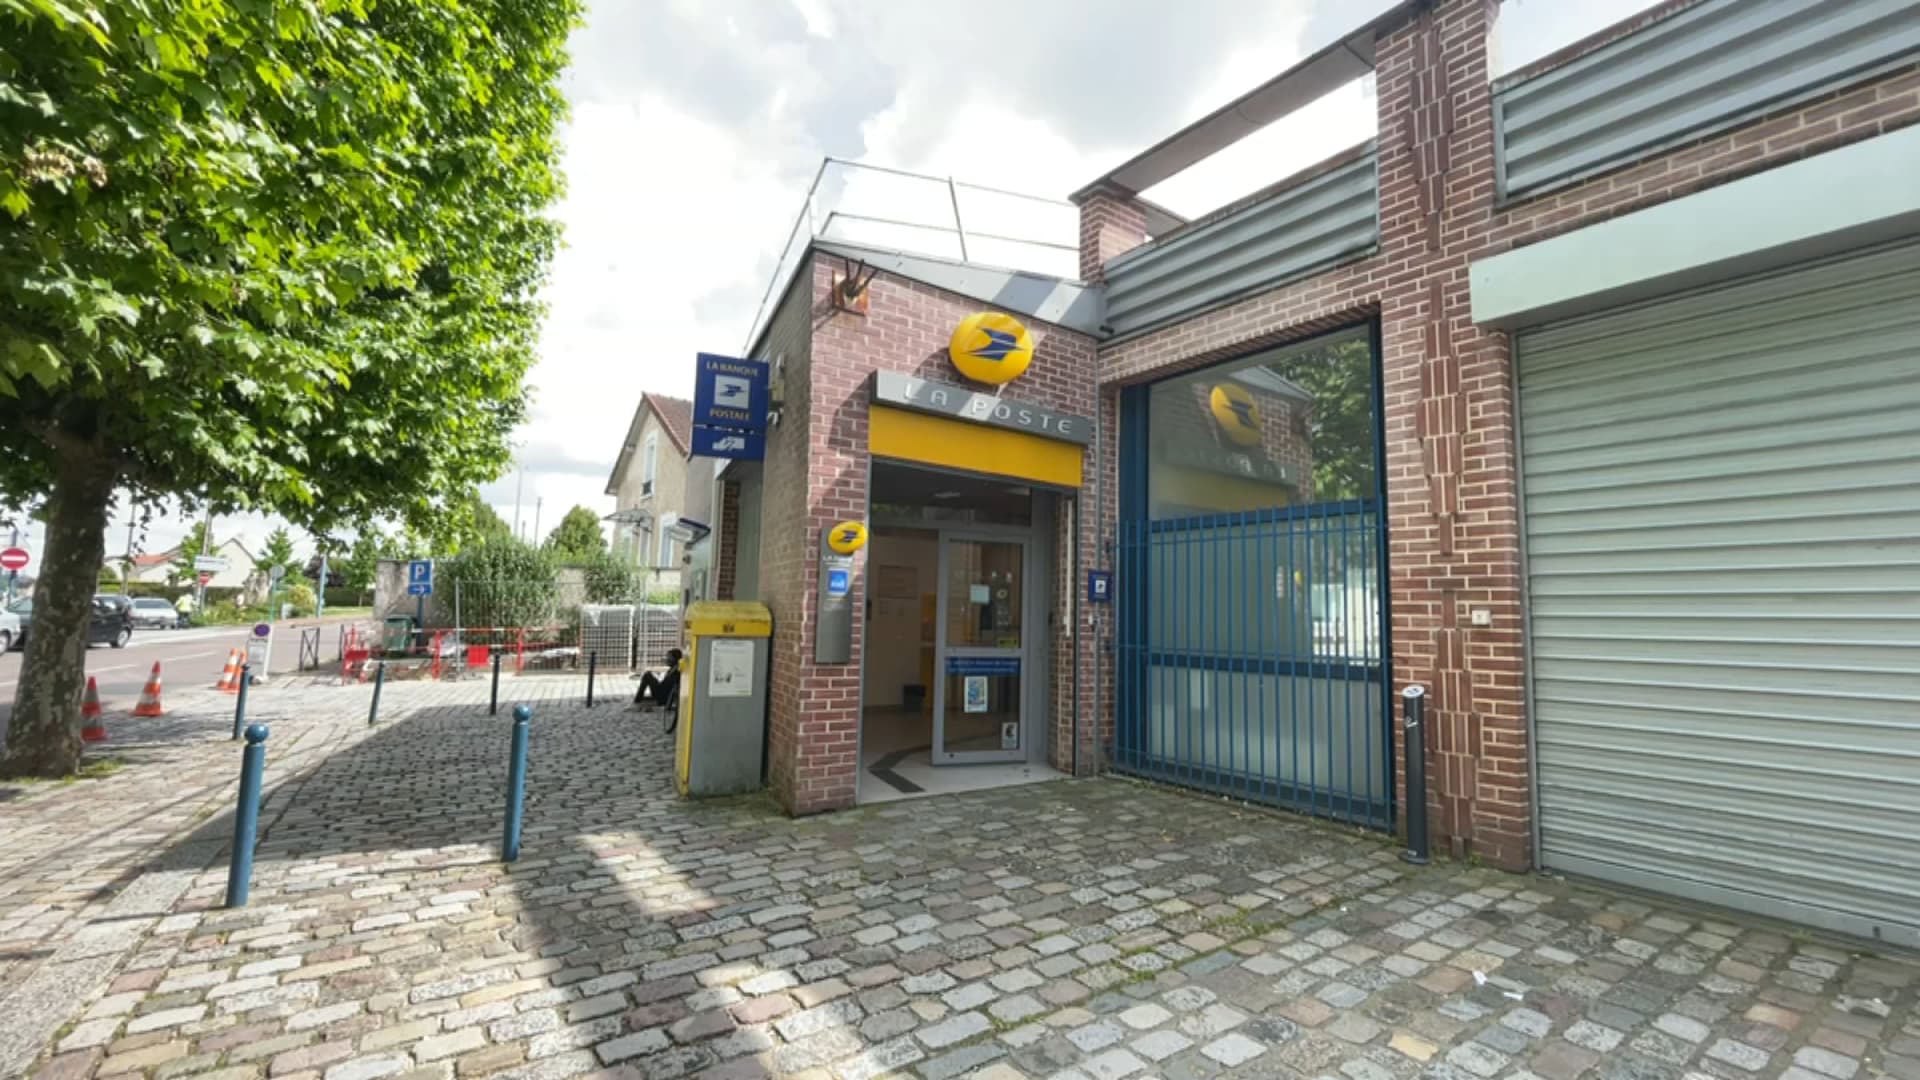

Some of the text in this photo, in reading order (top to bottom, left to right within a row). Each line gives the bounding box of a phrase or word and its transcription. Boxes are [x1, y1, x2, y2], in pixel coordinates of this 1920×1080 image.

[706, 361, 719, 370] LA
[710, 407, 750, 420] POSTALE
[904, 383, 1072, 433] LA POSTE
[415, 563, 425, 580] P
